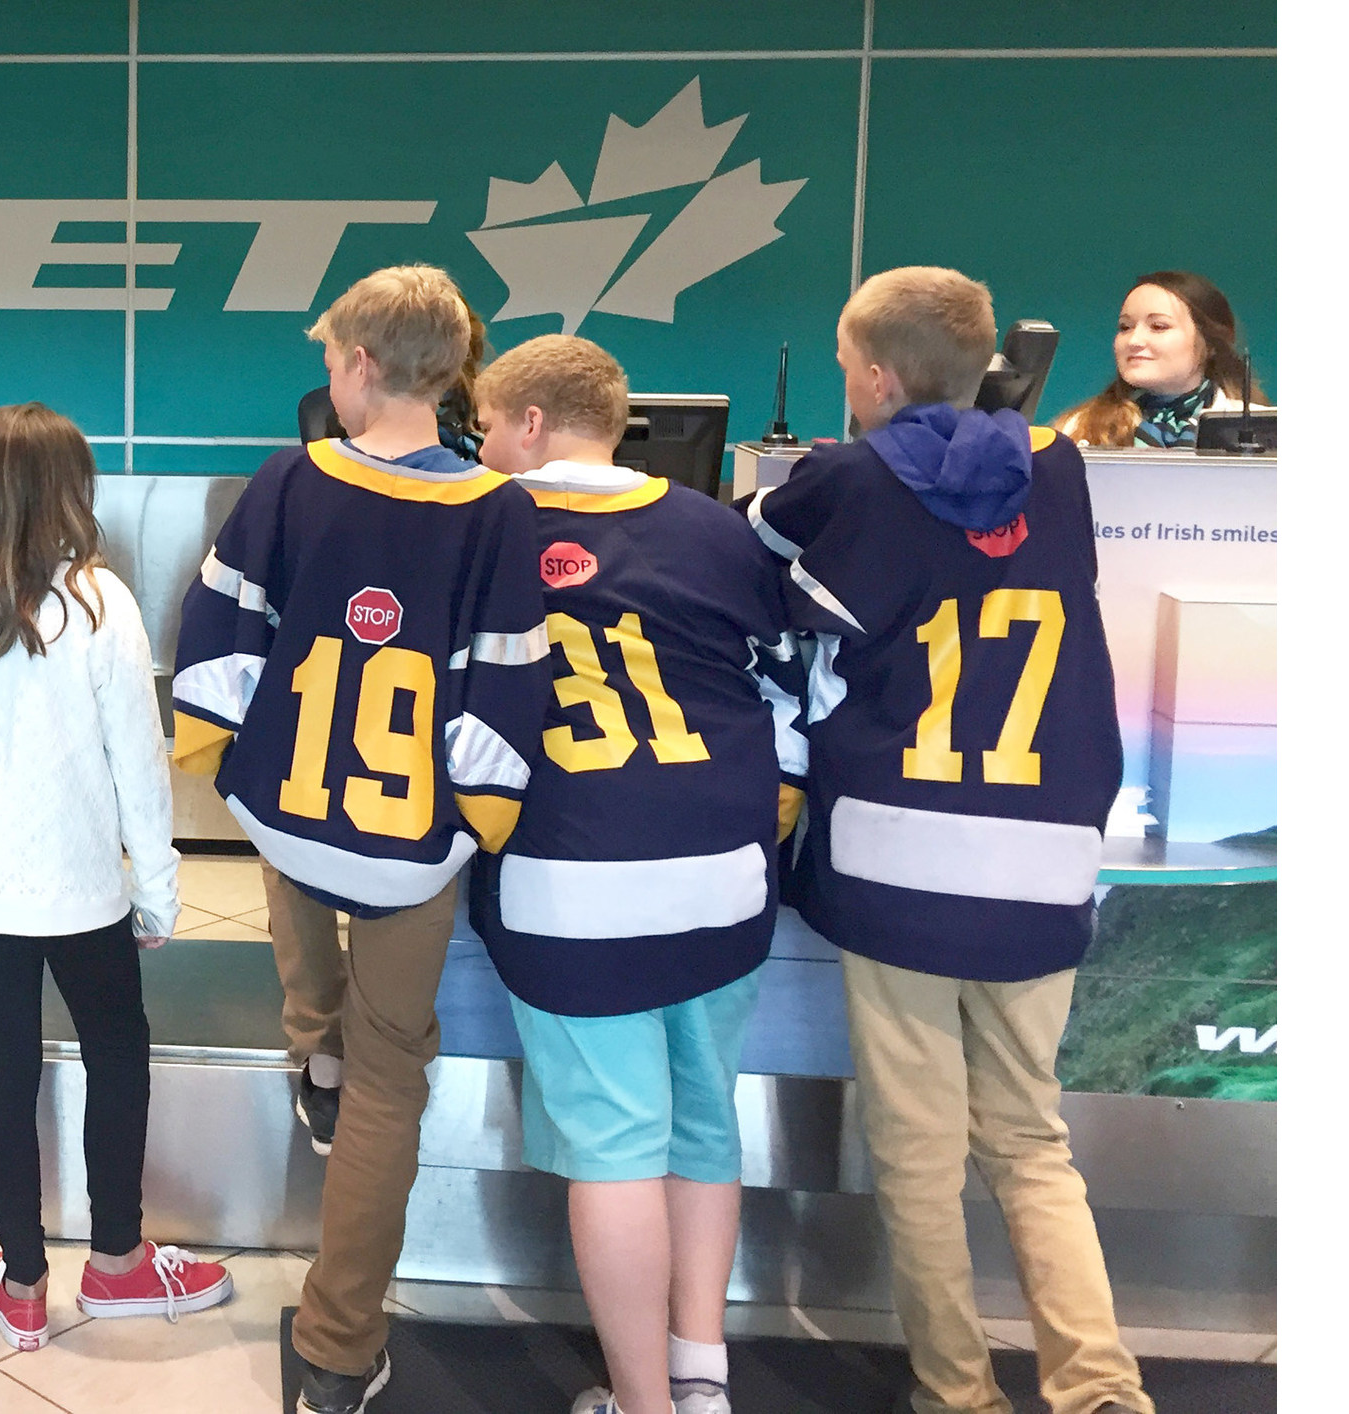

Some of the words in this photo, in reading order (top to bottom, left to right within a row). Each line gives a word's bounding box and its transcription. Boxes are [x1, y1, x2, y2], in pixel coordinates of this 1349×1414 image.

[544, 557, 592, 577] STOP
[1093, 521, 1126, 539] les
[1131, 522, 1152, 540] of
[1157, 523, 1205, 541] Irish
[353, 604, 396, 627] STOP
[542, 612, 711, 774] 31
[902, 588, 1067, 786] 17
[279, 636, 436, 841] 19
